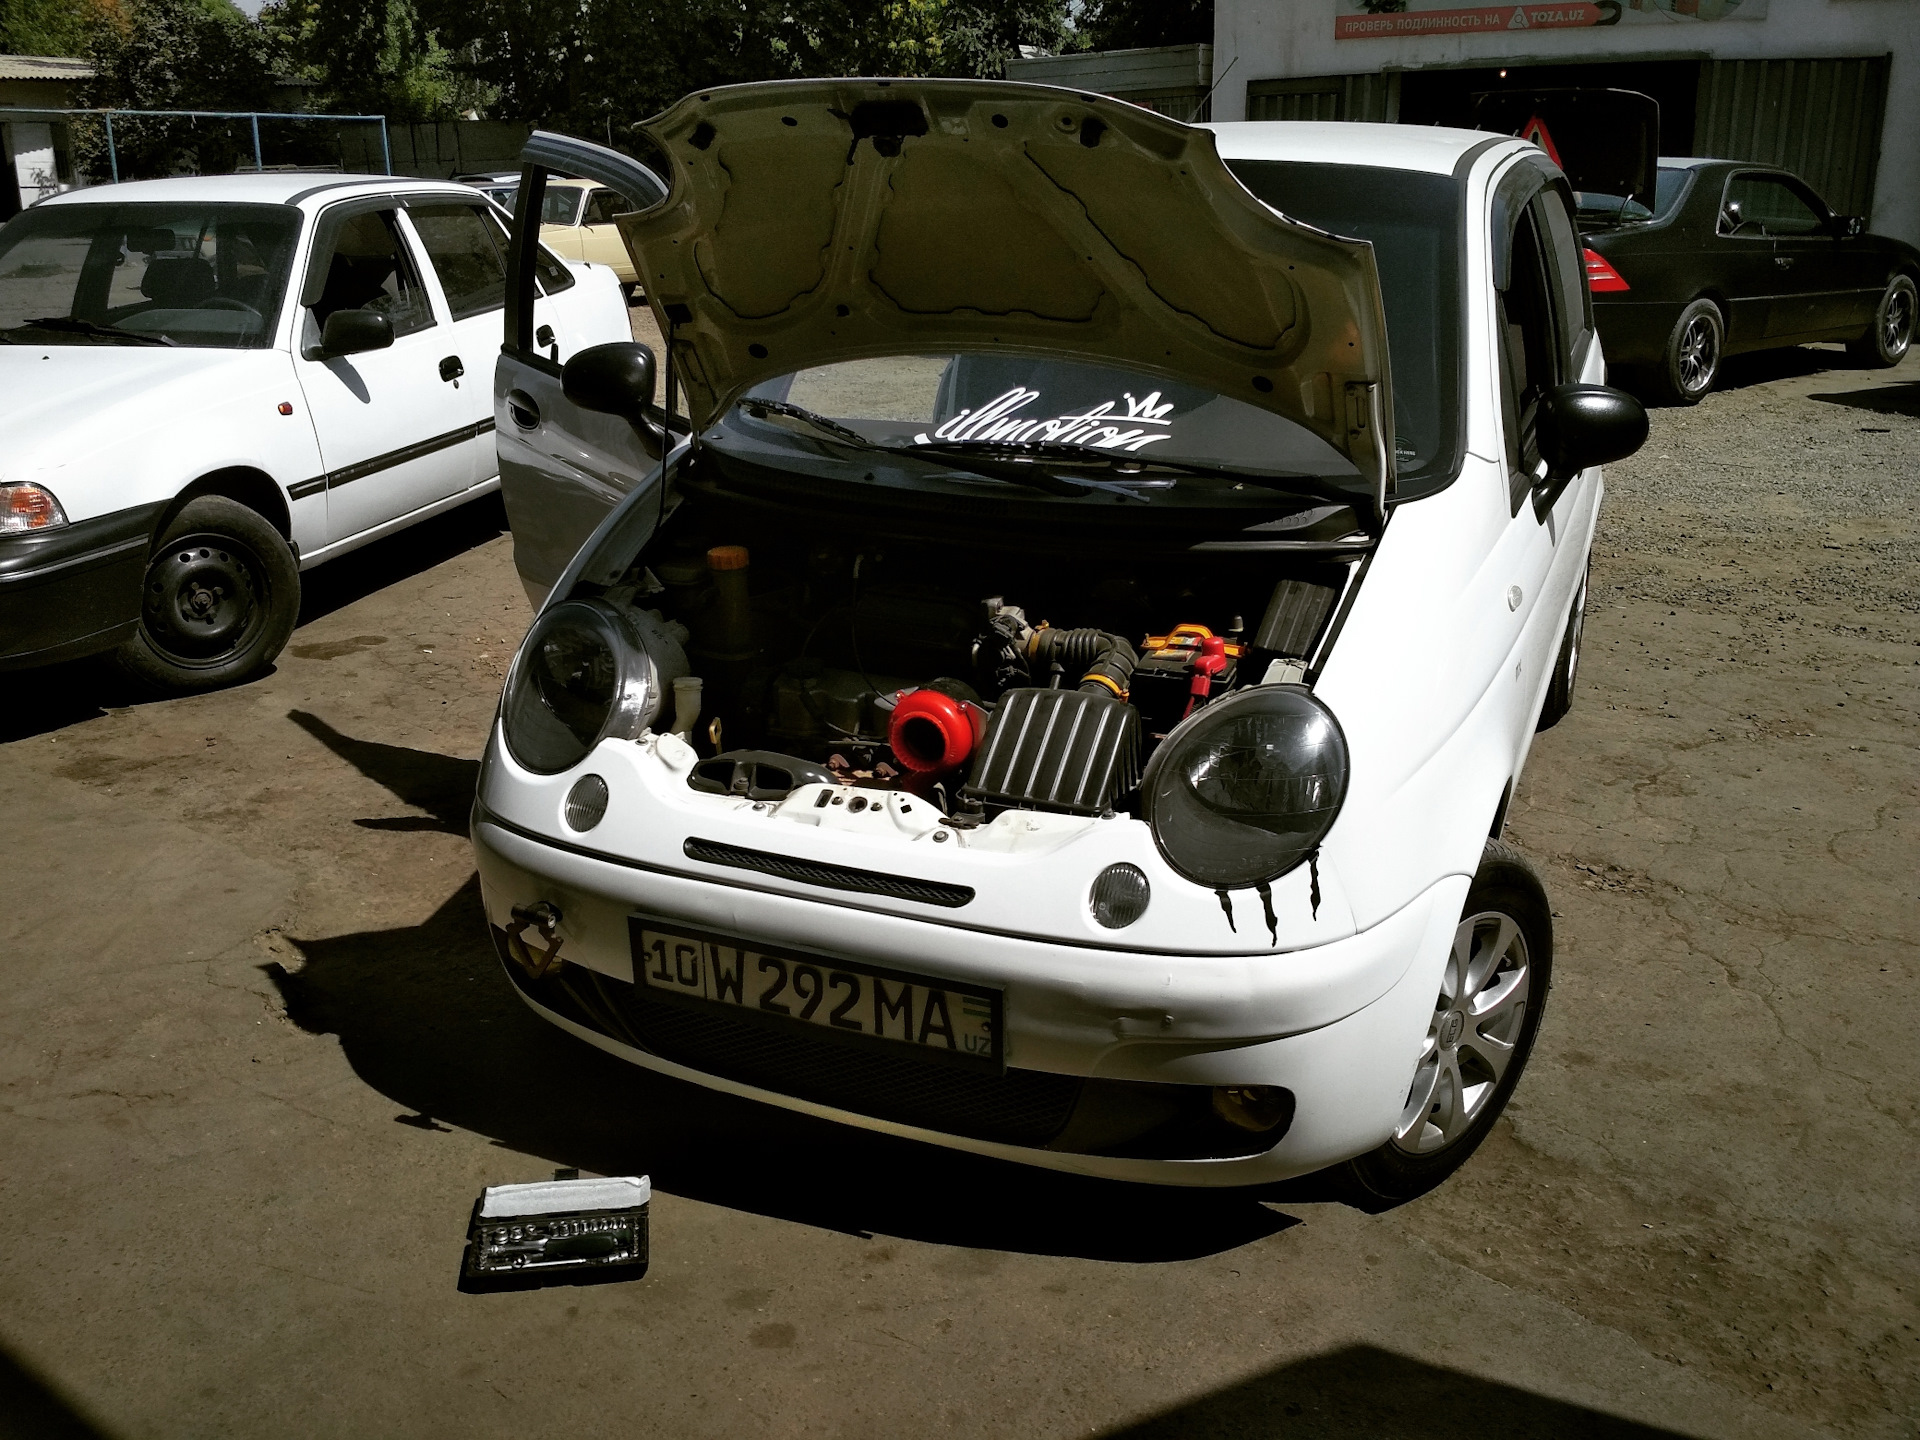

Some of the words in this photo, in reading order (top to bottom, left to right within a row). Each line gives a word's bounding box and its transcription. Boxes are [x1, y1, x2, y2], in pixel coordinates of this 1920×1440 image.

[1345, 19, 1394, 33] ПРОВЕРЬ
[1397, 14, 1481, 31] ПОДЛИННОСТЬ
[1484, 13, 1500, 25] НА
[1530, 8, 1585, 23] TOZA.UZ
[651, 939, 699, 988] 10
[709, 942, 745, 1005] W
[757, 957, 863, 1032] 292
[872, 976, 957, 1051] MA
[964, 1033, 990, 1056] UZ
